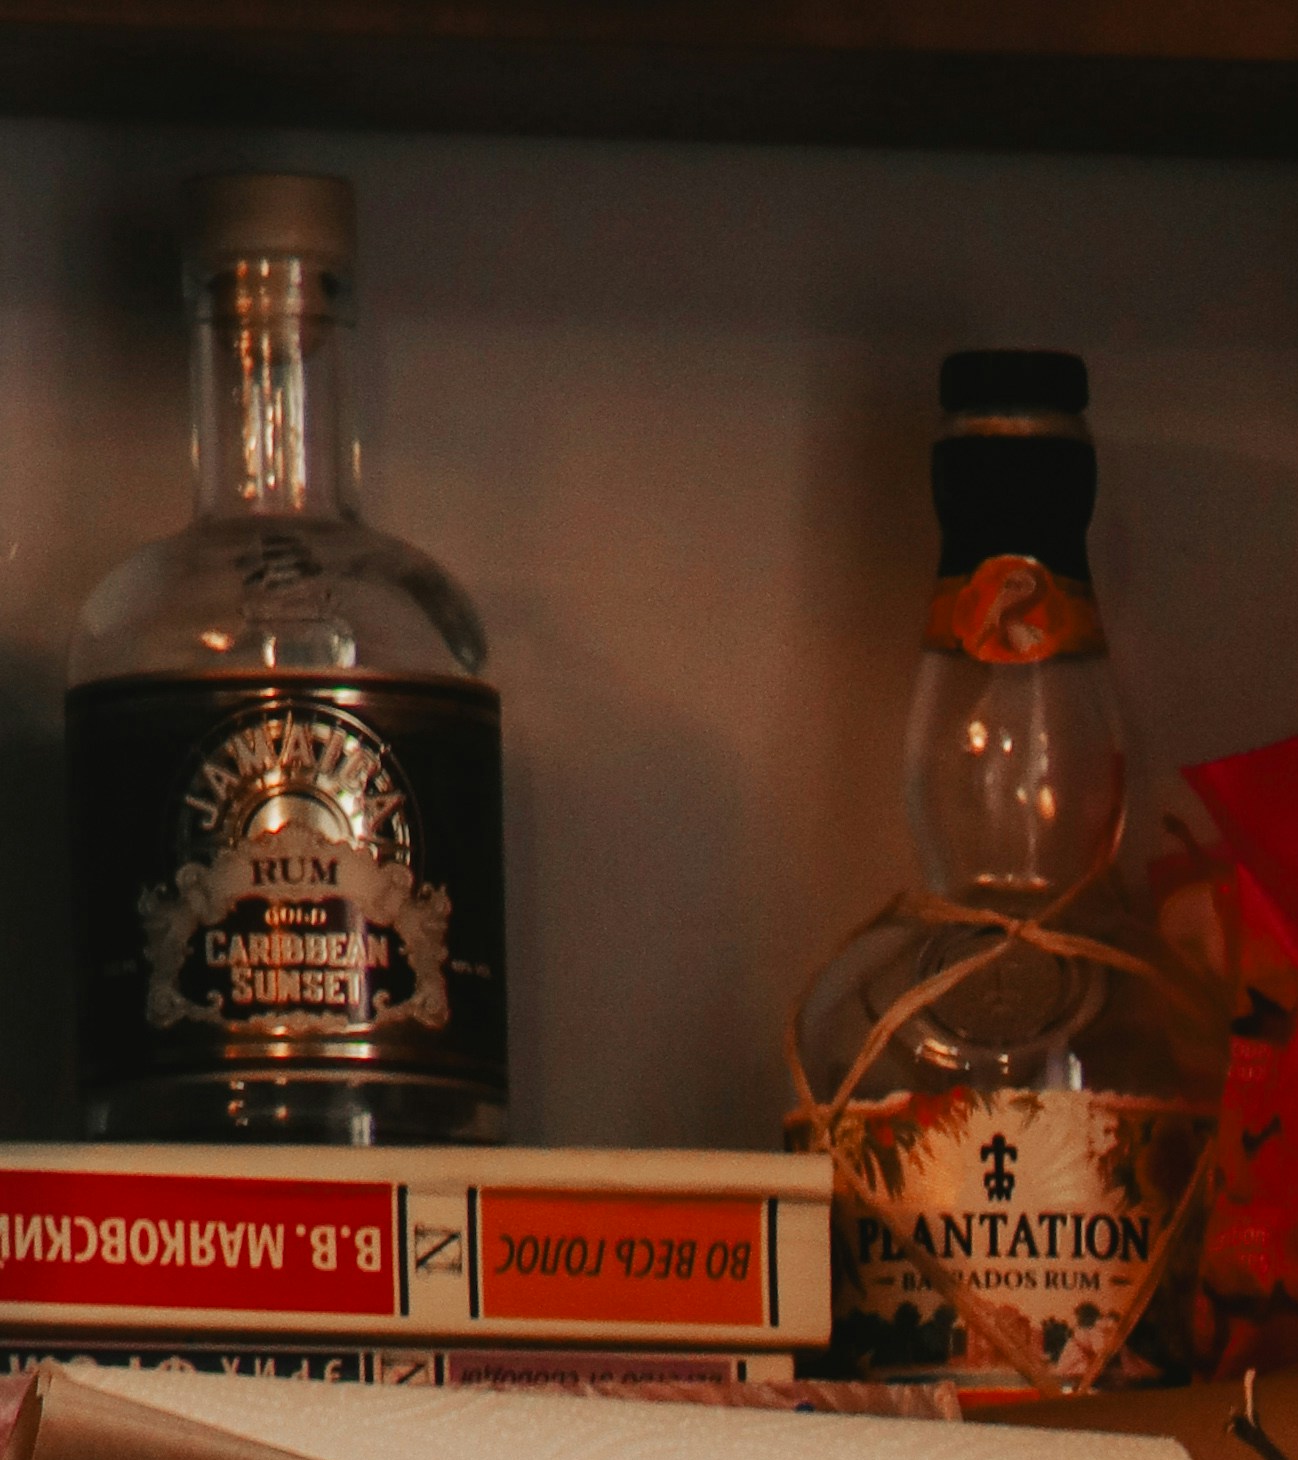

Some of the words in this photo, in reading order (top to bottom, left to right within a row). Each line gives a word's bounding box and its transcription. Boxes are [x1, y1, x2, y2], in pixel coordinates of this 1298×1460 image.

[186, 716, 405, 839] JAMAICA
[252, 855, 338, 886] RUM
[264, 906, 326, 926] GOLD
[205, 929, 389, 968] CARIBBEAN
[231, 967, 363, 1005] SUNSET
[295, 1225, 382, 1272] В.В.
[495, 1233, 604, 1277] ГОЛОС
[615, 1236, 698, 1280] ВЕСЬ
[856, 1211, 1151, 1265] PLANTATION
[704, 1240, 752, 1282] ВО
[1044, 1269, 1100, 1292] RUM
